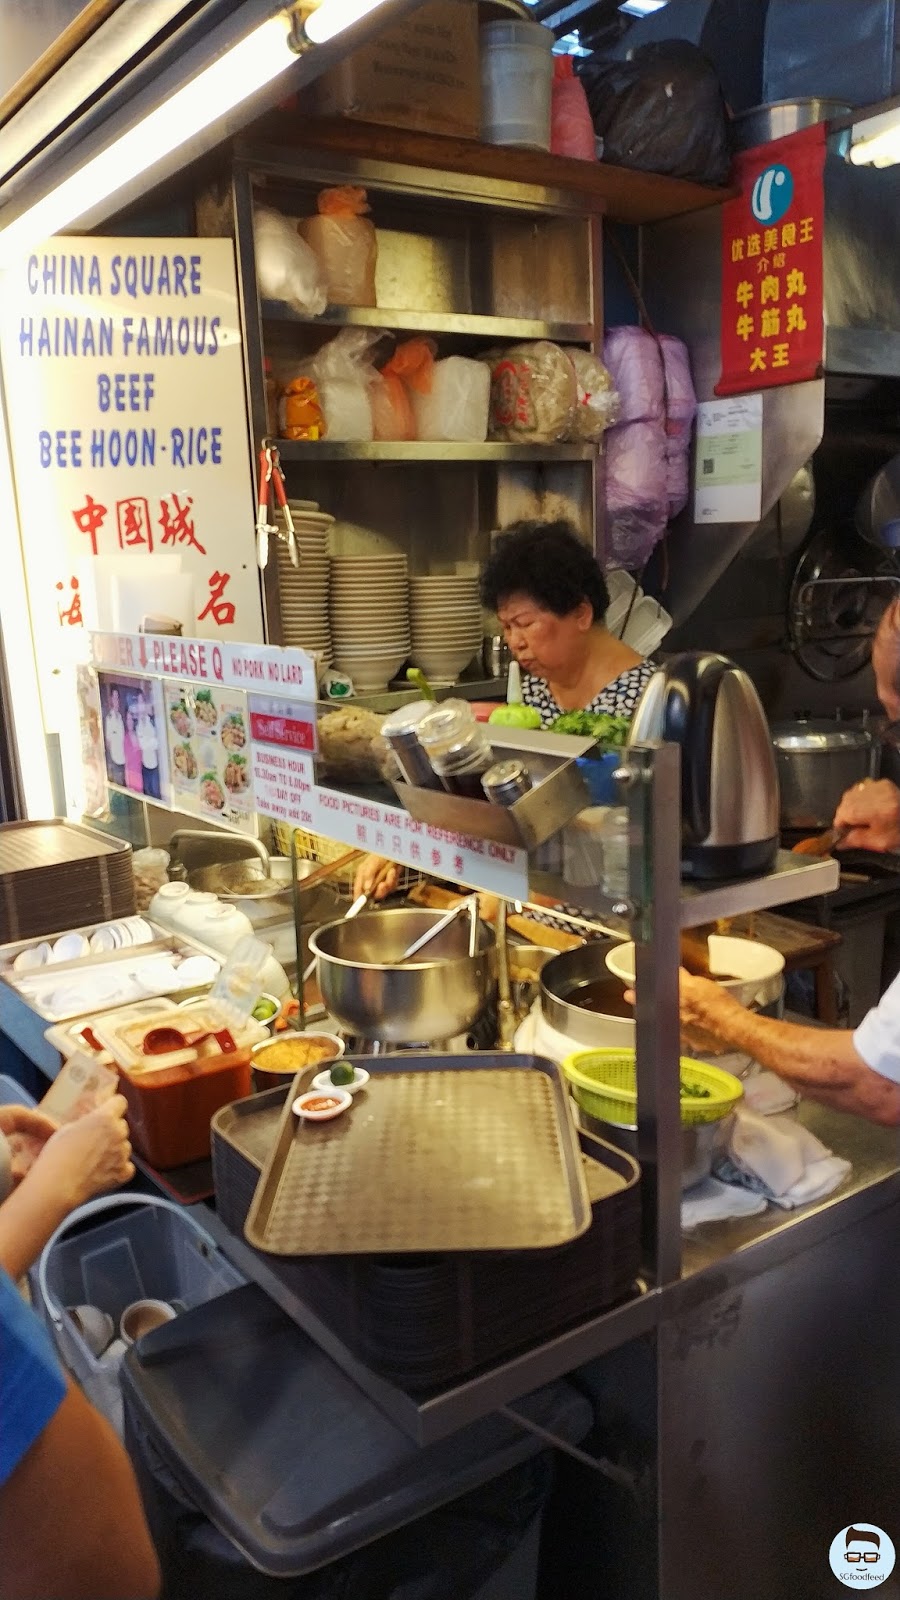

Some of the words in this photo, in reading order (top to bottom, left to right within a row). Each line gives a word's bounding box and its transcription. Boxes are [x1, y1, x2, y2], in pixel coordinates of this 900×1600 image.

[731, 217, 813, 262] 优选美食王
[28, 255, 102, 295] CHINA
[110, 255, 202, 298] SQUARE
[757, 252, 785, 273] 介绍
[736, 268, 807, 309] 牛肉丸
[19, 317, 113, 356] HAINAN
[123, 316, 221, 355] FAMOUS
[736, 303, 807, 341] 牛筋丸
[750, 343, 790, 372] 大王
[97, 373, 155, 412] BEEF
[39, 430, 82, 468] BEE
[72, 493, 207, 555] 中國城
[153, 640, 207, 677] PLEASE
[212, 647, 224, 681] Q
[232, 657, 242, 676] NO
[243, 658, 264, 679] PORK
[268, 661, 279, 681] NO
[281, 664, 303, 684] LARD
[256, 752, 286, 769] BUSINESS
[288, 760, 304, 774] HOUR
[319, 794, 339, 810] FOOD
[342, 800, 380, 821] PICTURES
[384, 813, 401, 828] ARE
[404, 817, 422, 833] FOR
[426, 824, 484, 854] REFERENCE
[488, 842, 515, 863] ONLY
